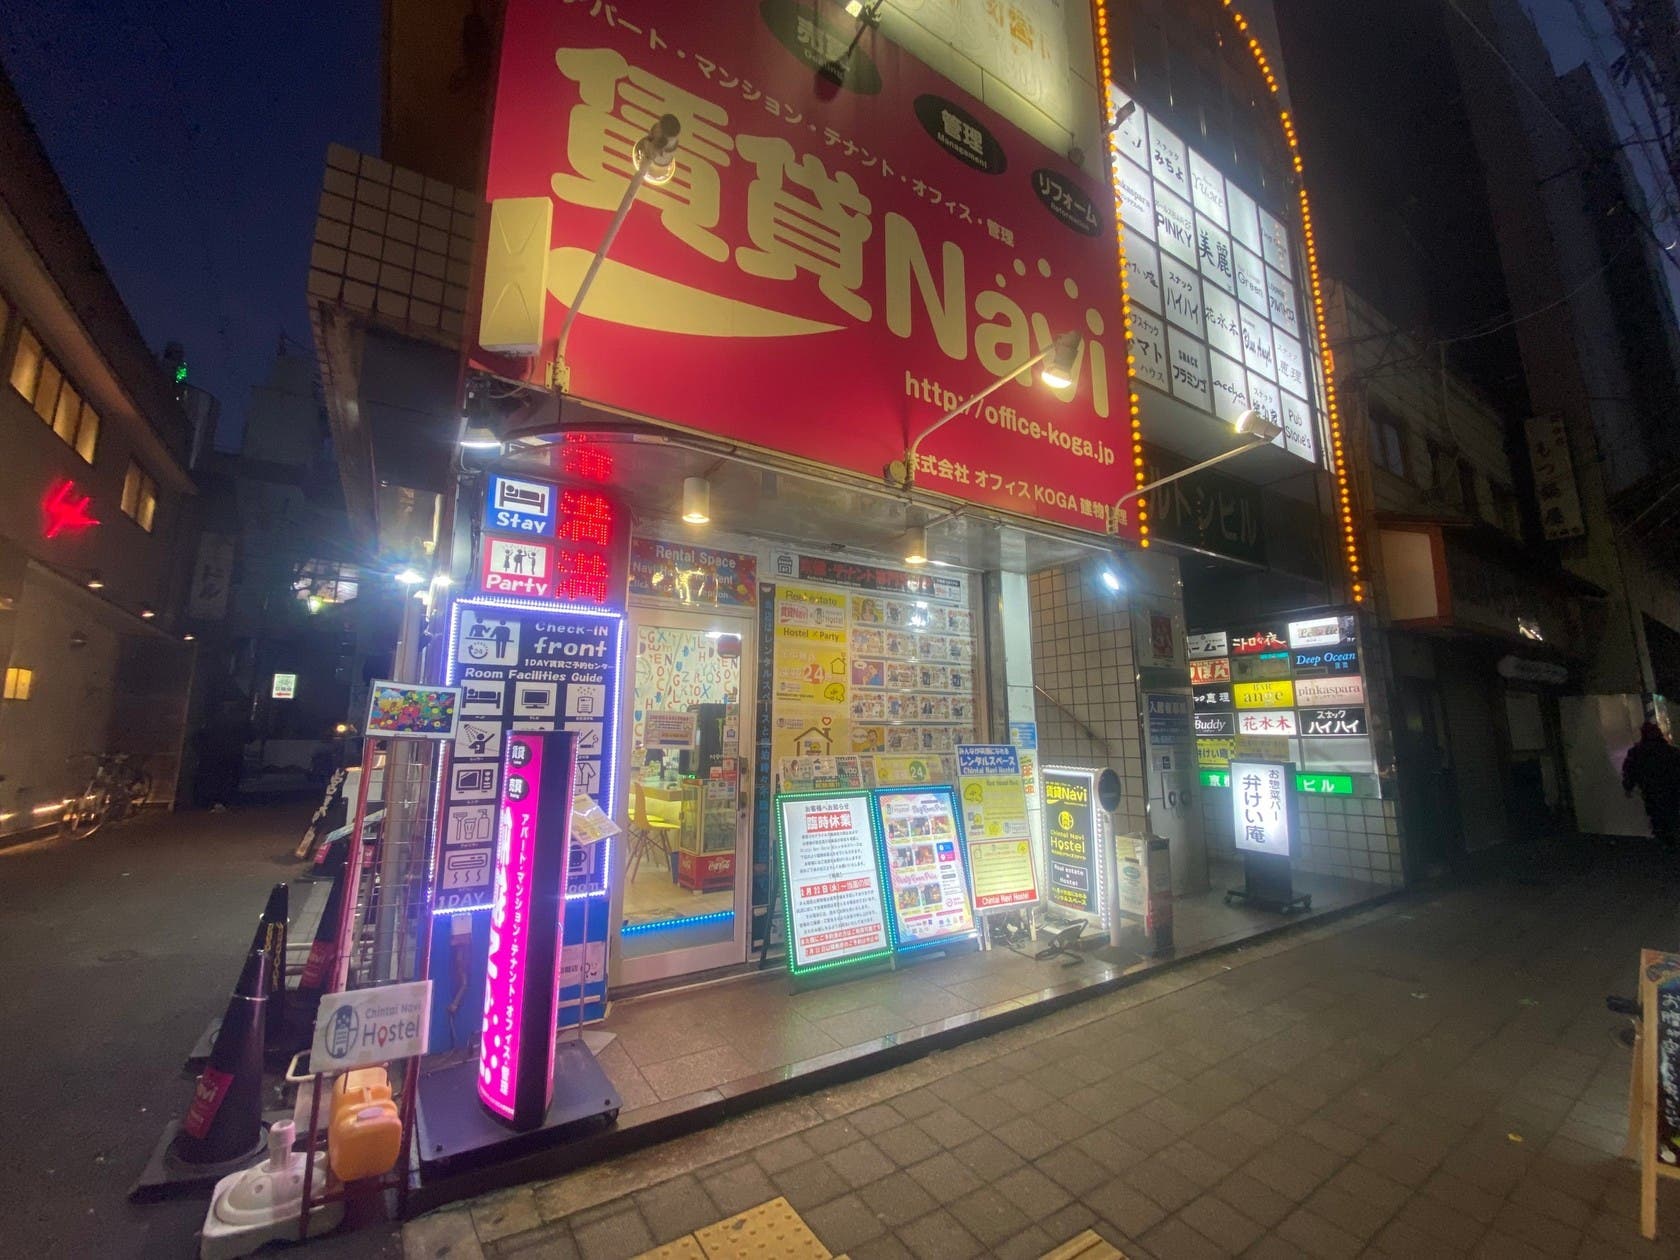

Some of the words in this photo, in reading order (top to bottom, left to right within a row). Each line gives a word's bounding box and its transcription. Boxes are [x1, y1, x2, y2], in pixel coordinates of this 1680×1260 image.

[941, 109, 983, 155] 管理
[1039, 173, 1098, 227] リフォーム
[1157, 213, 1192, 247] PINKY
[1199, 229, 1232, 278] 美麗
[1169, 272, 1192, 292] スナック
[1167, 287, 1198, 324] ハイハイ
[1173, 365, 1207, 393] フラミンゴ
[975, 467, 1031, 500] オフィス
[1034, 484, 1078, 512] KOGA
[497, 511, 546, 533] Stay
[656, 545, 695, 563] Rental
[700, 551, 736, 569] Space
[486, 574, 548, 596] Party
[784, 627, 809, 638] Hostel
[820, 632, 840, 643] Party
[534, 636, 608, 658] front
[1297, 655, 1321, 667] Deep
[1324, 652, 1356, 663] Ocean
[465, 667, 503, 679] Room
[508, 668, 567, 681] Facilities
[571, 672, 604, 683] Guide
[1298, 684, 1361, 698] pinkaspara
[1195, 718, 1227, 733] Buddy
[1243, 715, 1292, 731] 花水木
[1317, 710, 1346, 720] スナック
[1309, 720, 1359, 734] ハイハイ
[960, 755, 1016, 767] レンタルスペース
[1303, 779, 1335, 793] ビル
[1242, 774, 1266, 844] 弁けい庵
[1050, 836, 1086, 853] Hostel
[364, 1005, 399, 1020] Chintai
[401, 1001, 421, 1016] Navi
[362, 1015, 420, 1048] Hostel
